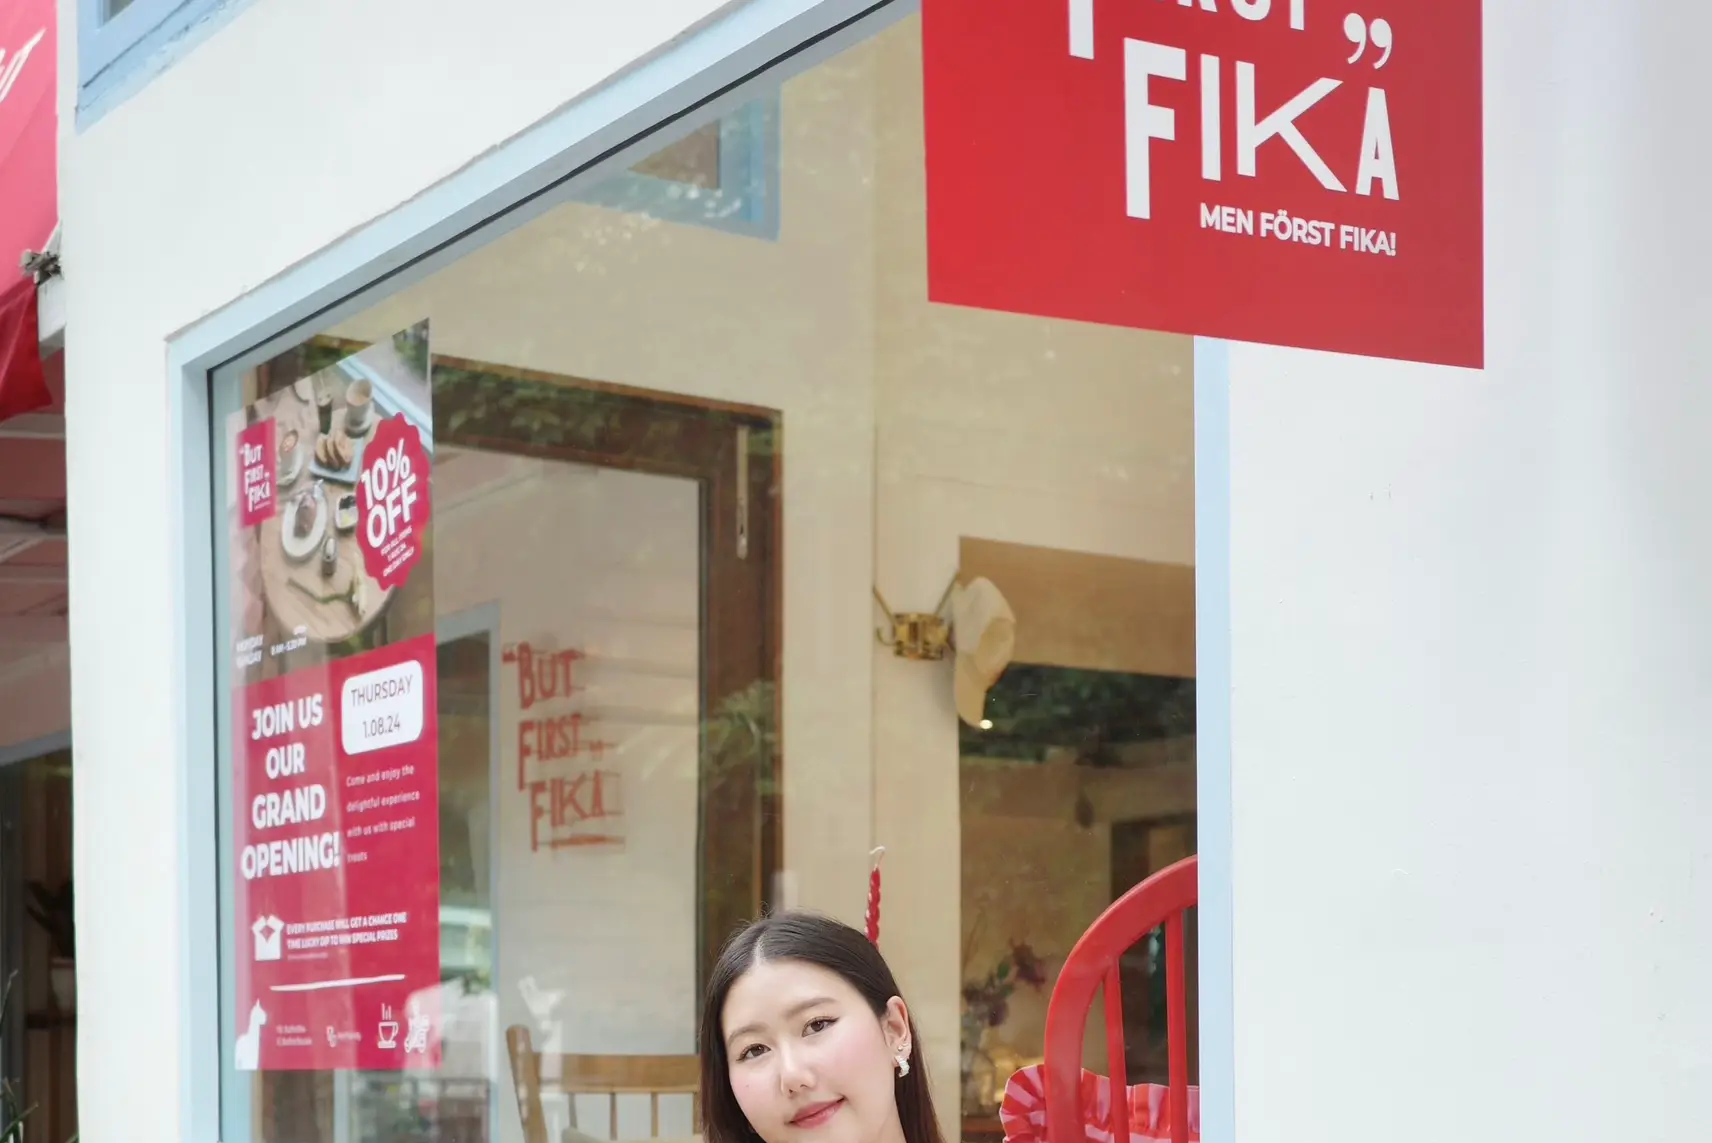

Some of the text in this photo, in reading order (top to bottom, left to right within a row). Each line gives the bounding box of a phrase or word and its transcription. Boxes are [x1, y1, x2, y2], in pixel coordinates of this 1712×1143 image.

[1200, 203, 1397, 257] MEN FÖRST FIKA!
[361, 438, 410, 510] 10%
[367, 473, 416, 548] OFF
[351, 675, 414, 708] THURSDAY
[252, 694, 324, 741] JOIN US
[363, 712, 401, 739] 1.08.24
[265, 743, 306, 779] OUR
[346, 764, 414, 788] Come and enjoy the
[252, 784, 326, 830] GRAND
[346, 790, 420, 813] delightful experience
[346, 816, 416, 838] with us with special
[240, 832, 340, 880] OPENING!
[350, 916, 362, 929] GET
[362, 916, 368, 928] A
[368, 913, 393, 927] CHANCE
[330, 935, 338, 946] TO
[351, 931, 377, 944] SPECIAL
